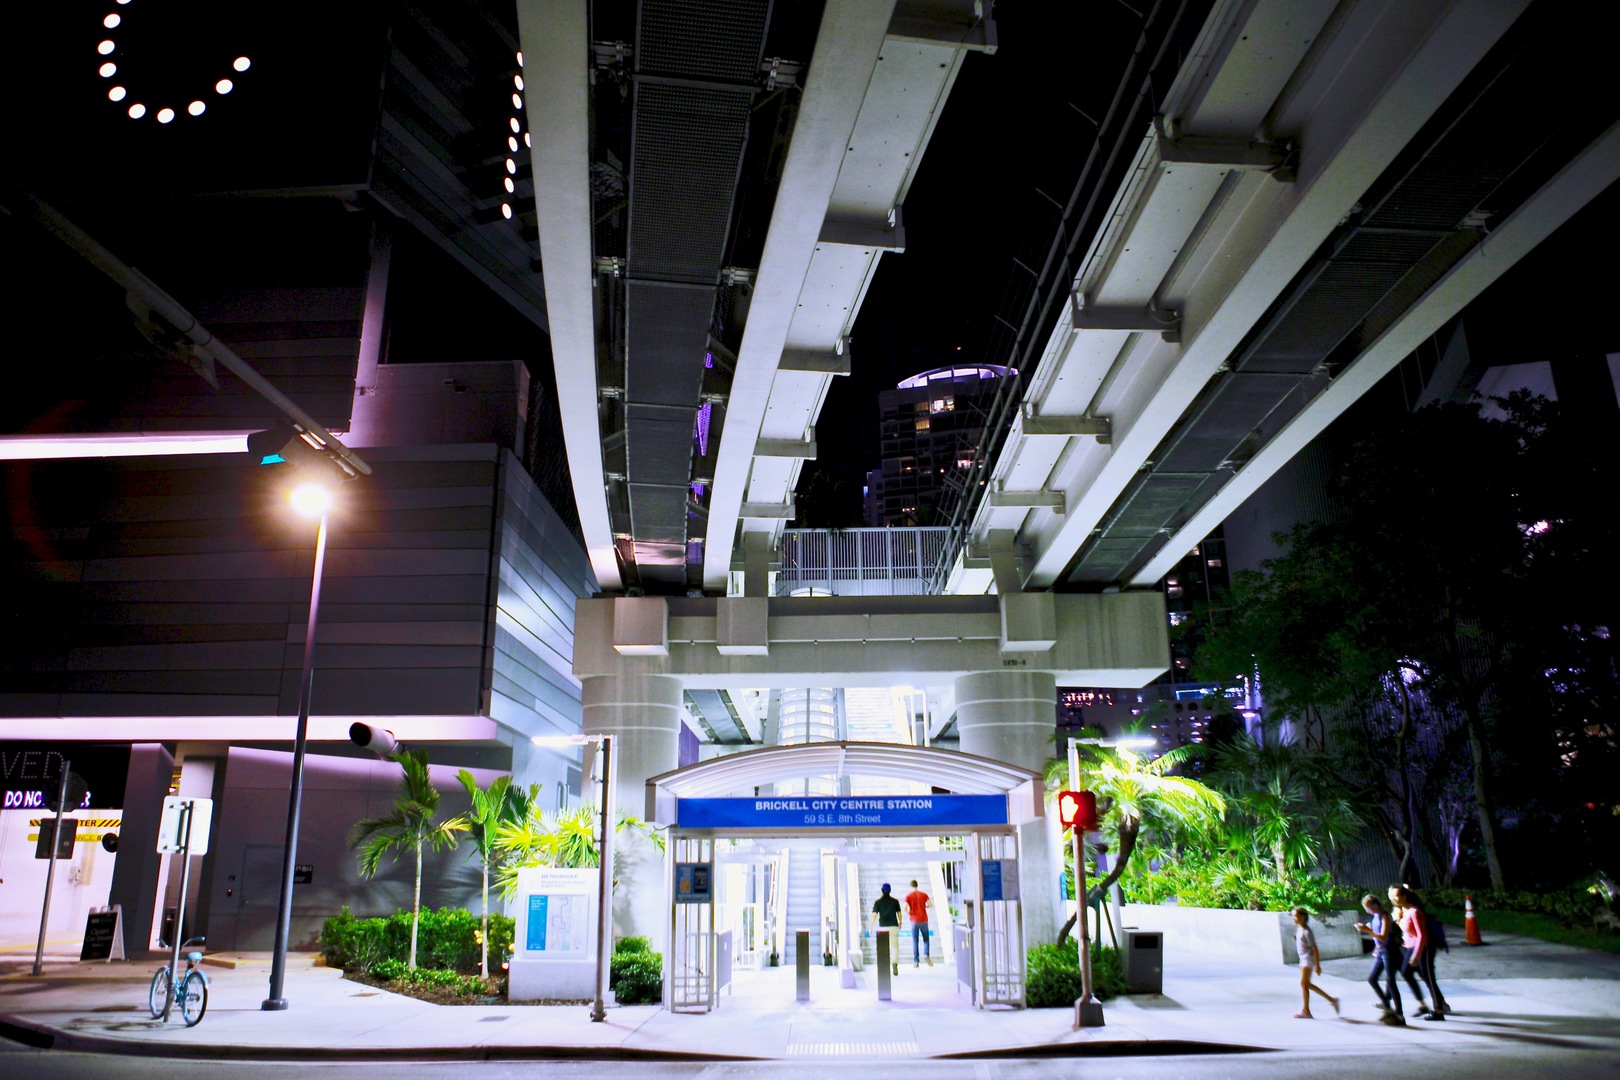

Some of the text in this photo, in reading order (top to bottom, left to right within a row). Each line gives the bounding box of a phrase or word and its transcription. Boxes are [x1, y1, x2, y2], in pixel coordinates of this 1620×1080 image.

[4, 790, 45, 808] DO NO
[755, 799, 933, 811] BRICKELL CITY CENTRE STATION
[79, 819, 97, 827] TER
[804, 814, 816, 824] 59
[838, 813, 853, 823] 8th
[854, 813, 881, 824] Street
